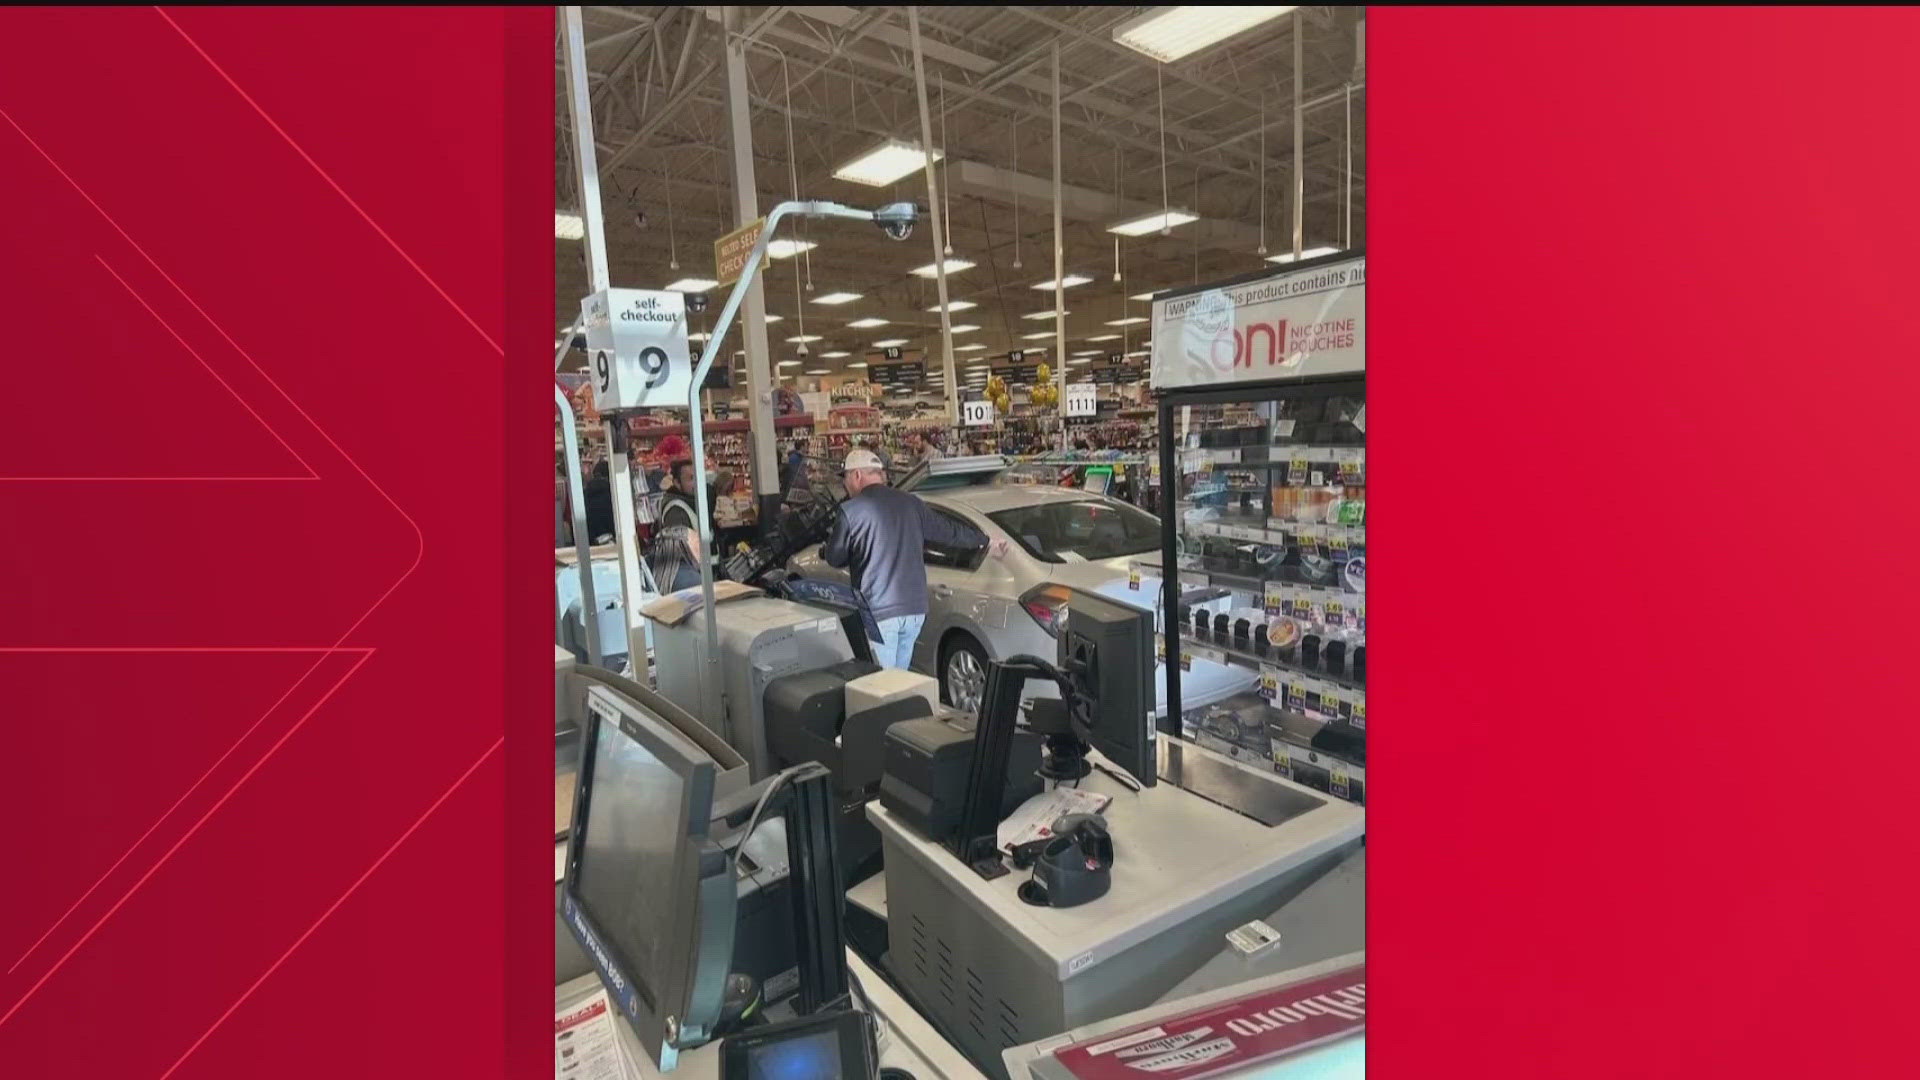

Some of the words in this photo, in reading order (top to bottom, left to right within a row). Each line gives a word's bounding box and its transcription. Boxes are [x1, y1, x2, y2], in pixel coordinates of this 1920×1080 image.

[1246, 283, 1288, 304] product
[1292, 270, 1346, 293] contains
[635, 297, 662, 309] self-
[620, 309, 678, 322] checkout
[1291, 319, 1355, 338] NICOTINE
[1211, 319, 1287, 372] on!
[1290, 333, 1355, 353] POUCHES
[597, 350, 609, 393] 9
[639, 346, 670, 389] 9
[831, 383, 874, 397] KITCHEN
[966, 405, 984, 420] 10
[1226, 983, 1365, 1036] rlboro
